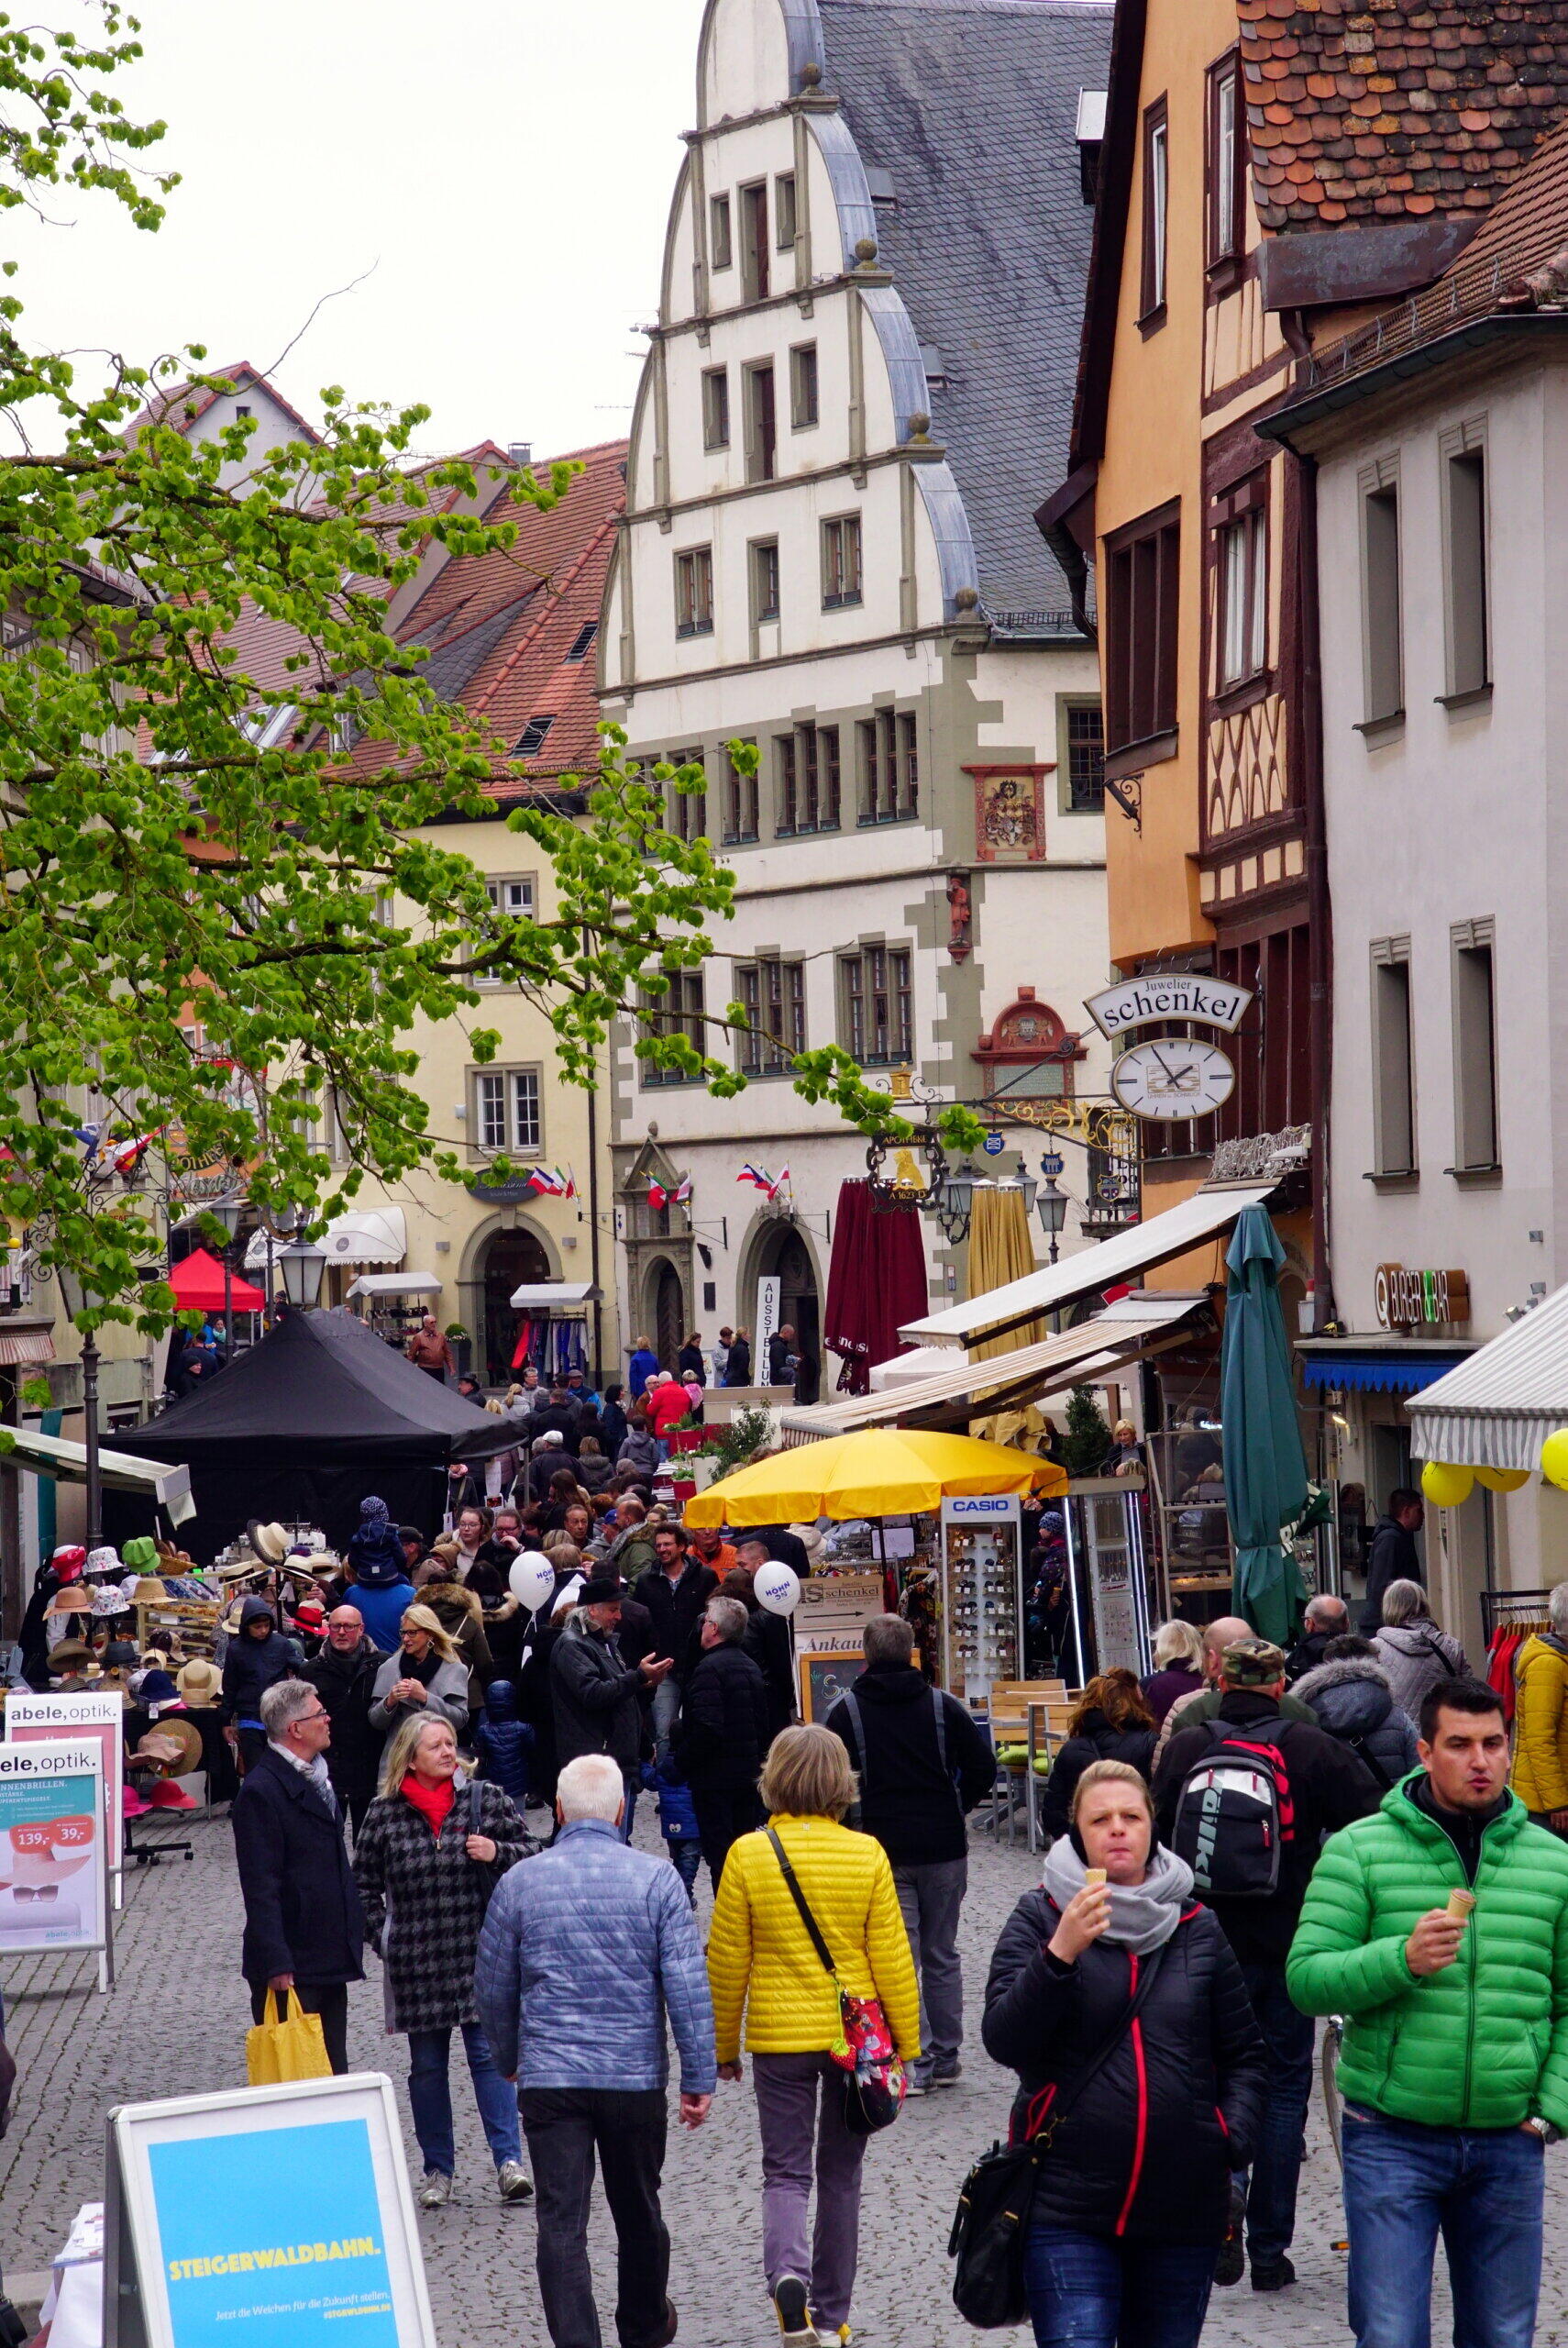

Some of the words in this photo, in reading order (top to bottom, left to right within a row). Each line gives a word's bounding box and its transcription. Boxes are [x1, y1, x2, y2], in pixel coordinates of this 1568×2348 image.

[1145, 979, 1192, 992] Juwelier
[1104, 987, 1240, 1028] schenkel
[1390, 1270, 1423, 1324] BURGER
[954, 1500, 1009, 1512] CASIO
[766, 1581, 790, 1597] HÖHN
[826, 1587, 879, 1597] schenkel
[18, 1833, 50, 1845] 139,-
[61, 1828, 84, 1840] 39,-
[169, 2236, 381, 2281] STEIGERWALDBAHN.
[215, 2309, 237, 2321] Jetzt
[237, 2307, 251, 2319] die
[252, 2303, 292, 2317] Weichen
[293, 2299, 307, 2313] für
[308, 2298, 322, 2309] die
[322, 2293, 359, 2308] Zukunft
[359, 2290, 392, 2303] stellen.
